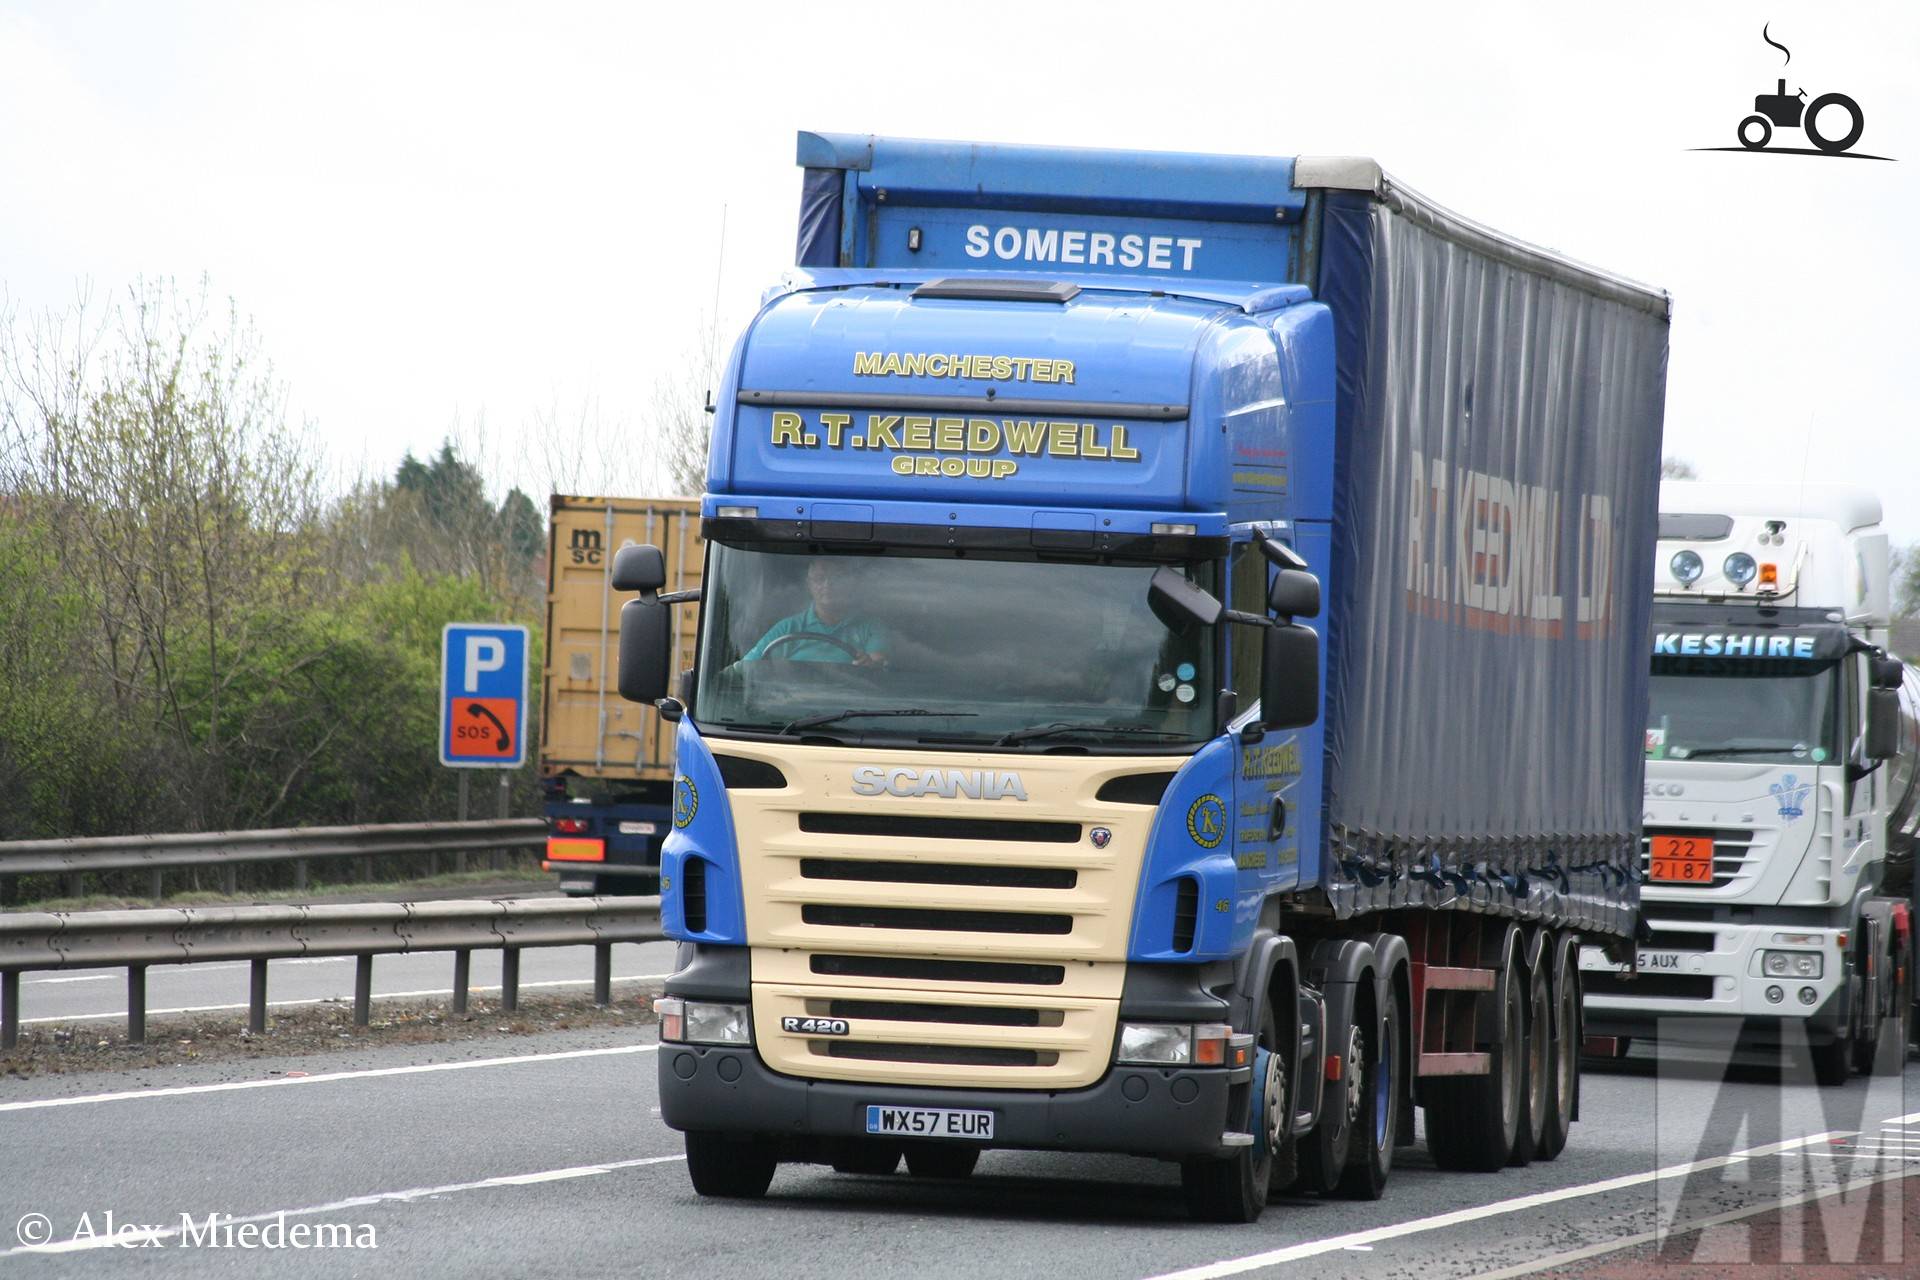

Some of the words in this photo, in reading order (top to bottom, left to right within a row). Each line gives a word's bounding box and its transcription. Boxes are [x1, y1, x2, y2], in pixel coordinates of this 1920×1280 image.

[965, 225, 1202, 271] SOMERSET
[853, 352, 1075, 383] MANCHESTER
[891, 455, 1017, 478] GROUP
[1654, 633, 1816, 659] KESHIRE
[464, 635, 505, 692] P
[457, 725, 490, 739] SOS
[852, 766, 1028, 801] SCANIA
[1668, 840, 1695, 857] 22
[1653, 862, 1710, 879] 2187
[1650, 954, 1679, 968] AUX
[784, 1017, 799, 1031] R
[801, 1019, 846, 1034] 420
[882, 1110, 940, 1133] WX57
[947, 1113, 991, 1135] EUR
